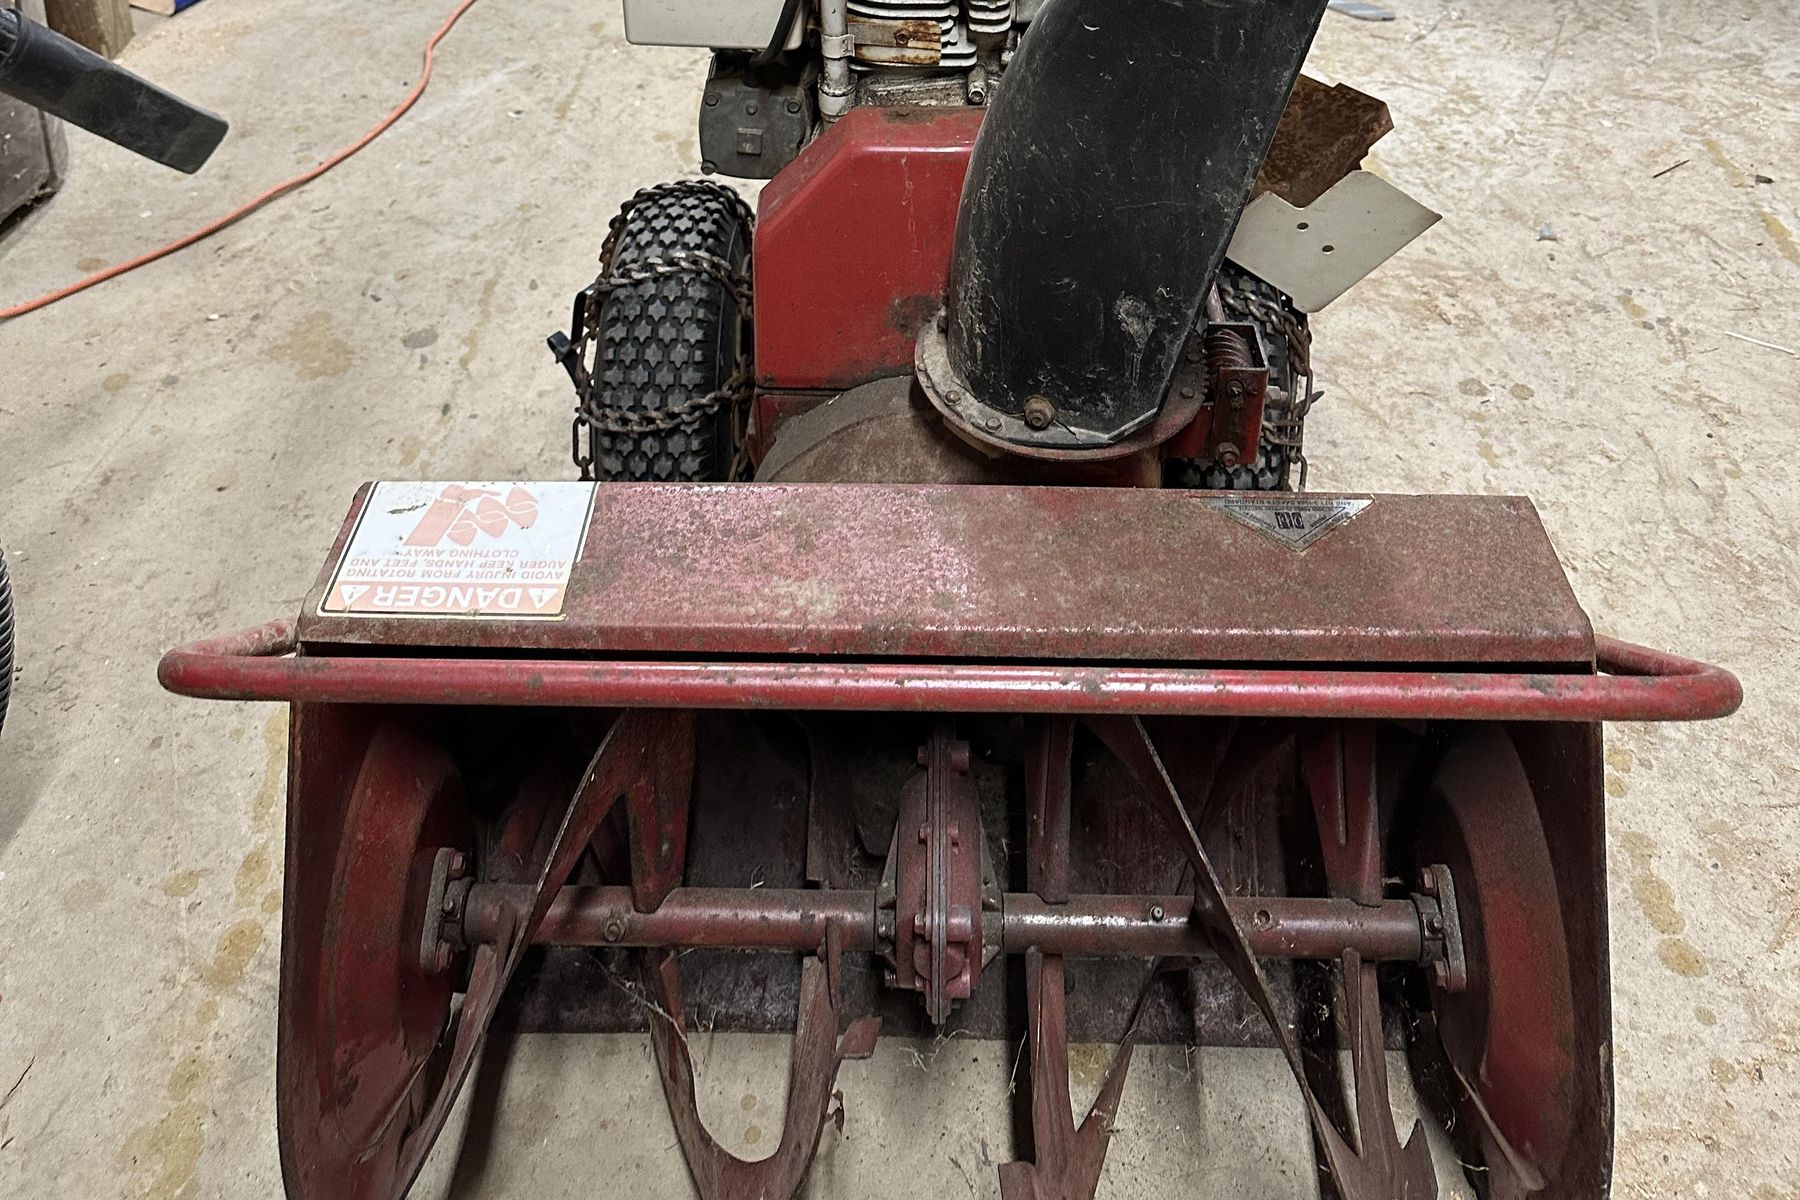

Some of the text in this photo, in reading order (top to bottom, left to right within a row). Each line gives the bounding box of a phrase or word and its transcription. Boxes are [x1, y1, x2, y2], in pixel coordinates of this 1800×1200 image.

[449, 549, 520, 558] CLOTHING
[350, 558, 380, 567] AND
[384, 558, 418, 567] FEET
[424, 558, 474, 569] HANDS,
[480, 560, 515, 569] KEEP
[346, 567, 564, 580] AVOID INJURY FROM ROTATING
[372, 585, 524, 609] DANGER
